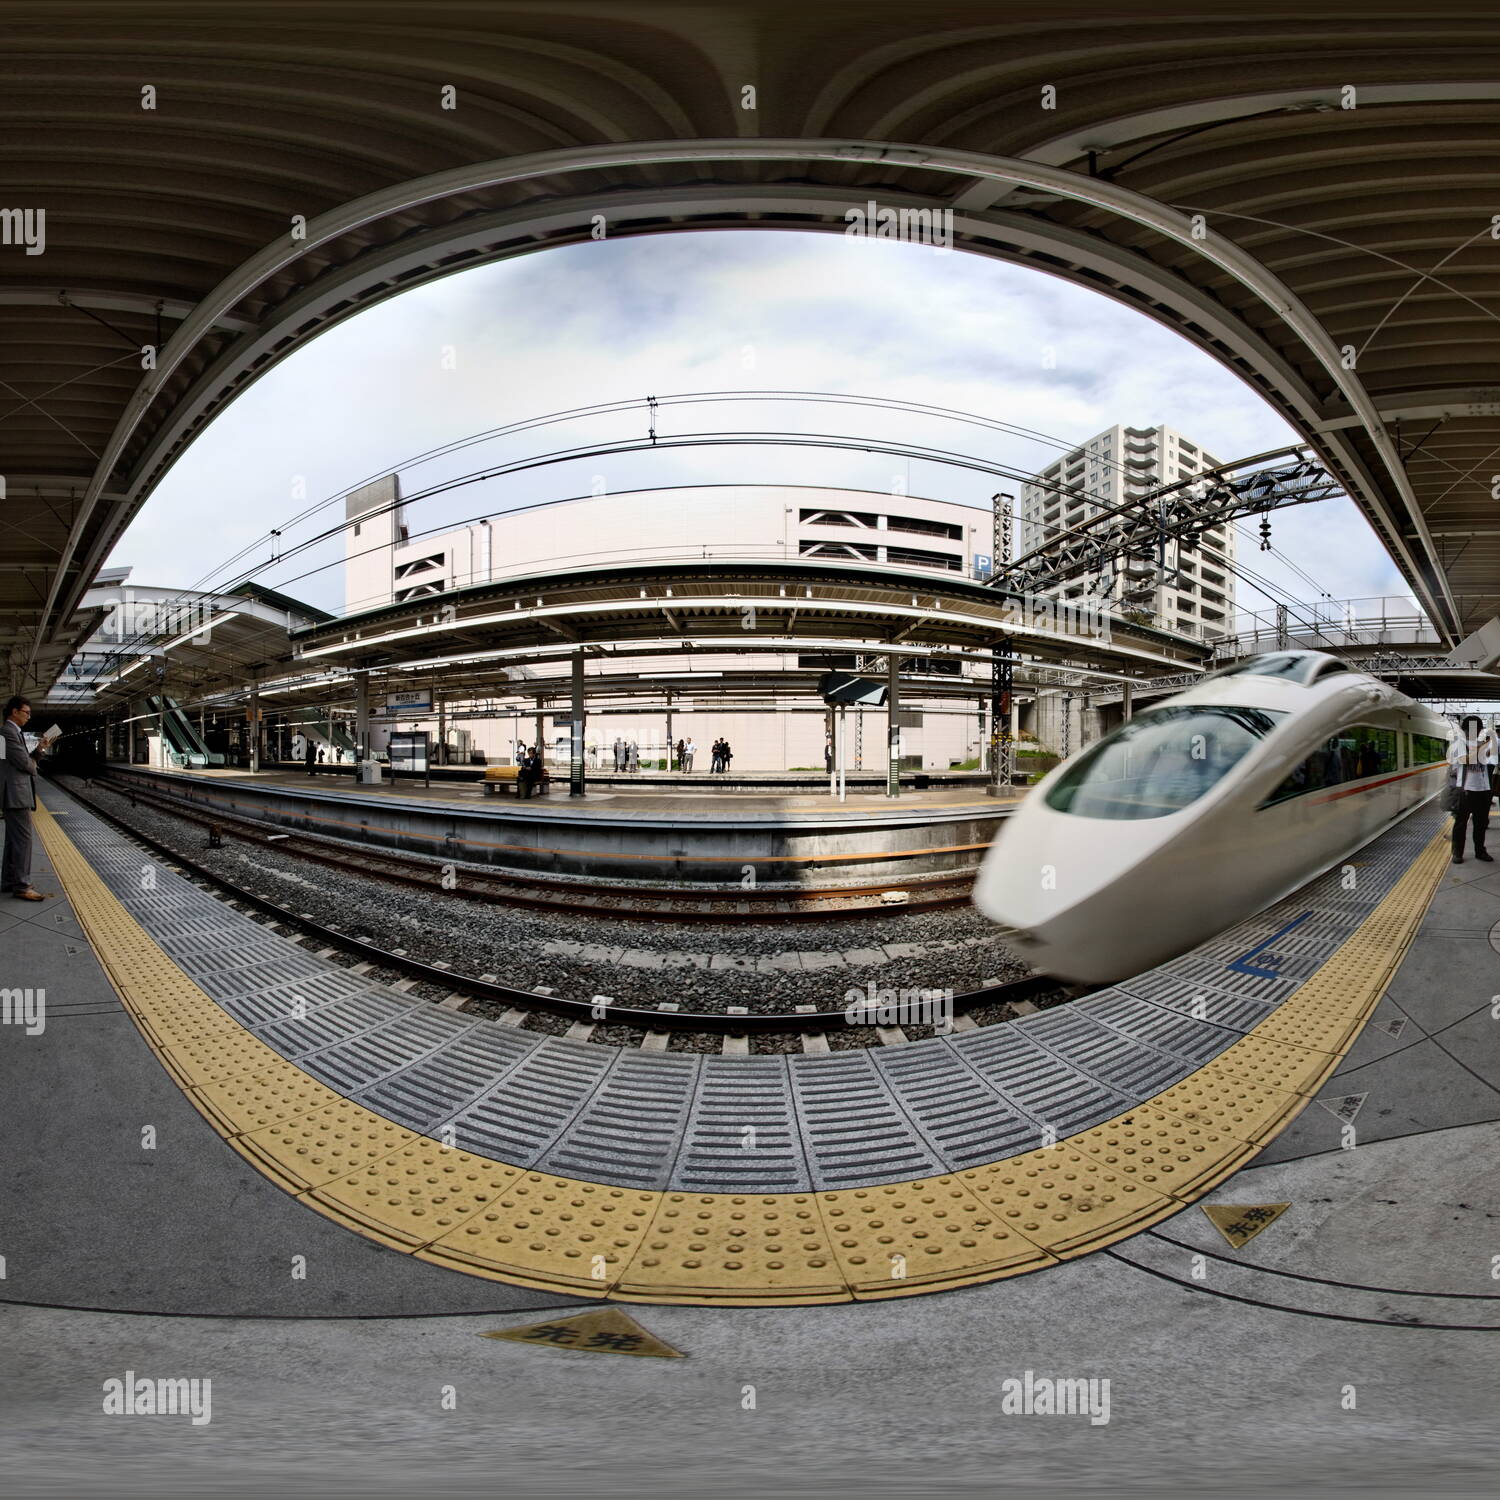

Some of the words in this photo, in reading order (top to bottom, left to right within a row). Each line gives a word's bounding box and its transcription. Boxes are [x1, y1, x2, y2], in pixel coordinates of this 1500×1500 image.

[978, 556, 989, 569] P
[1225, 1207, 1276, 1238] 先発
[523, 1325, 645, 1351] 先発
